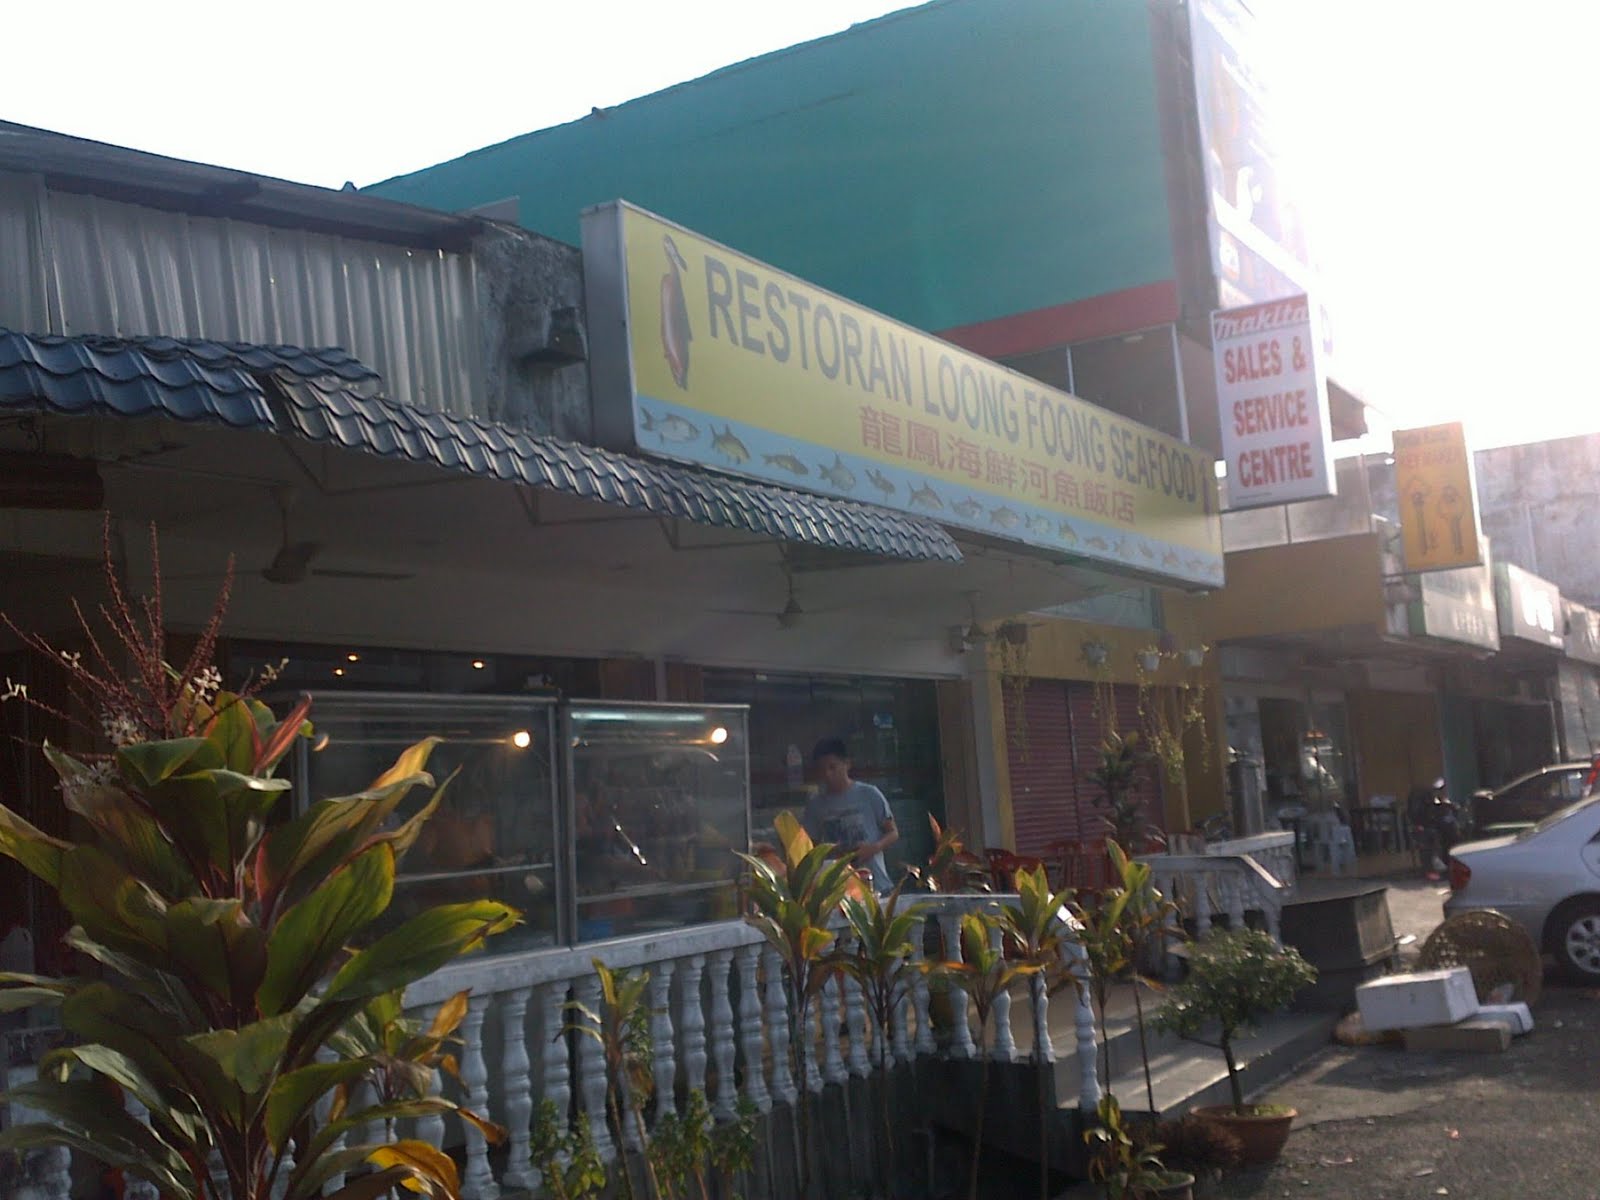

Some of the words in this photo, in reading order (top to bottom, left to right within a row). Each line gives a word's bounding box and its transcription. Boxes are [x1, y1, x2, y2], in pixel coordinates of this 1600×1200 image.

[704, 254, 912, 406] RESTORAN
[920, 346, 1019, 443] LOONG
[1024, 388, 1107, 473] FOONG
[1109, 424, 1196, 501] SEAFOOD
[1224, 339, 1282, 384] SALES
[1292, 336, 1306, 372] &
[1233, 390, 1309, 437] SERVICE
[859, 405, 1136, 526] 龍鳳海鮮河魚飯店
[1238, 442, 1314, 488] CENTRE
